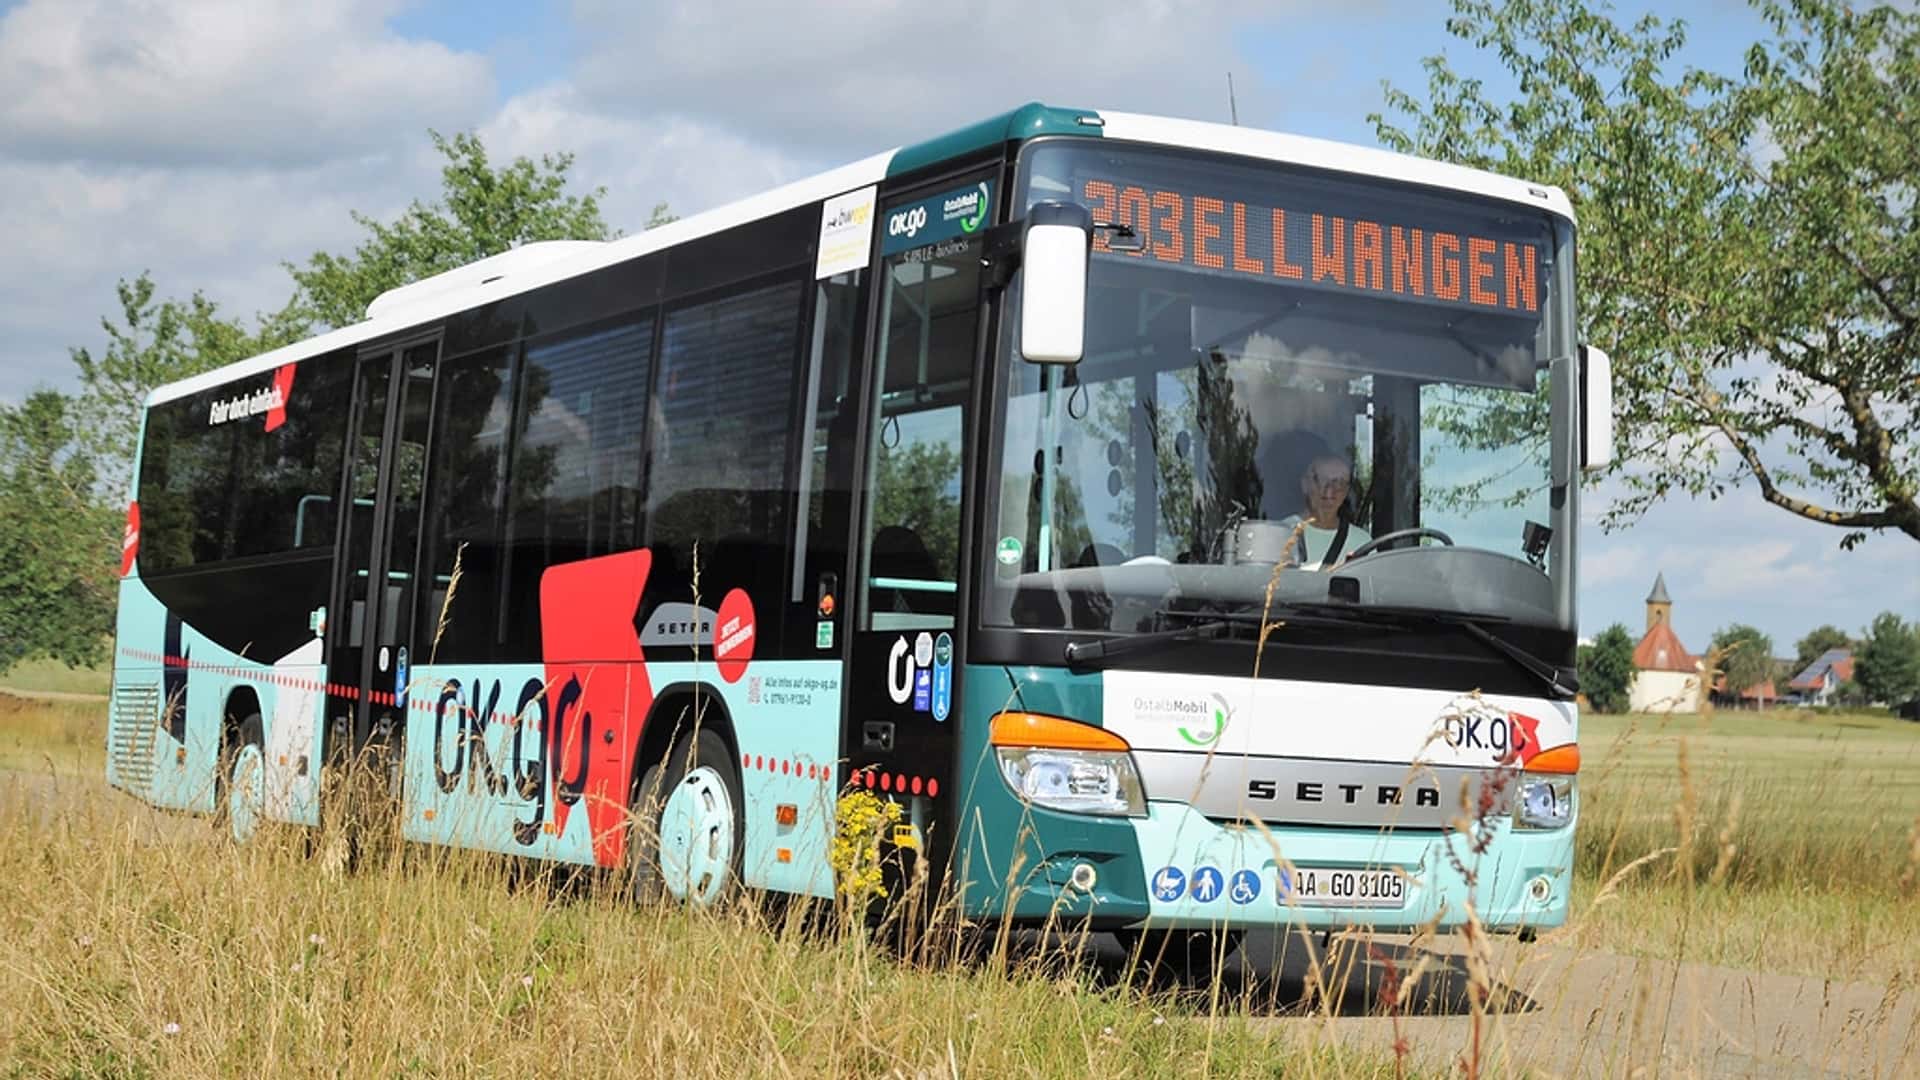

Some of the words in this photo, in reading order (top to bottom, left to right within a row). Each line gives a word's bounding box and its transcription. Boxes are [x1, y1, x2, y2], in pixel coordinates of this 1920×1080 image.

[1193, 196, 1537, 312] ELLWANGEN
[658, 622, 710, 635] SETRA
[1133, 697, 1208, 713] OstalbMobil
[1248, 780, 1440, 807] SETRA
[1331, 873, 1355, 897] GO
